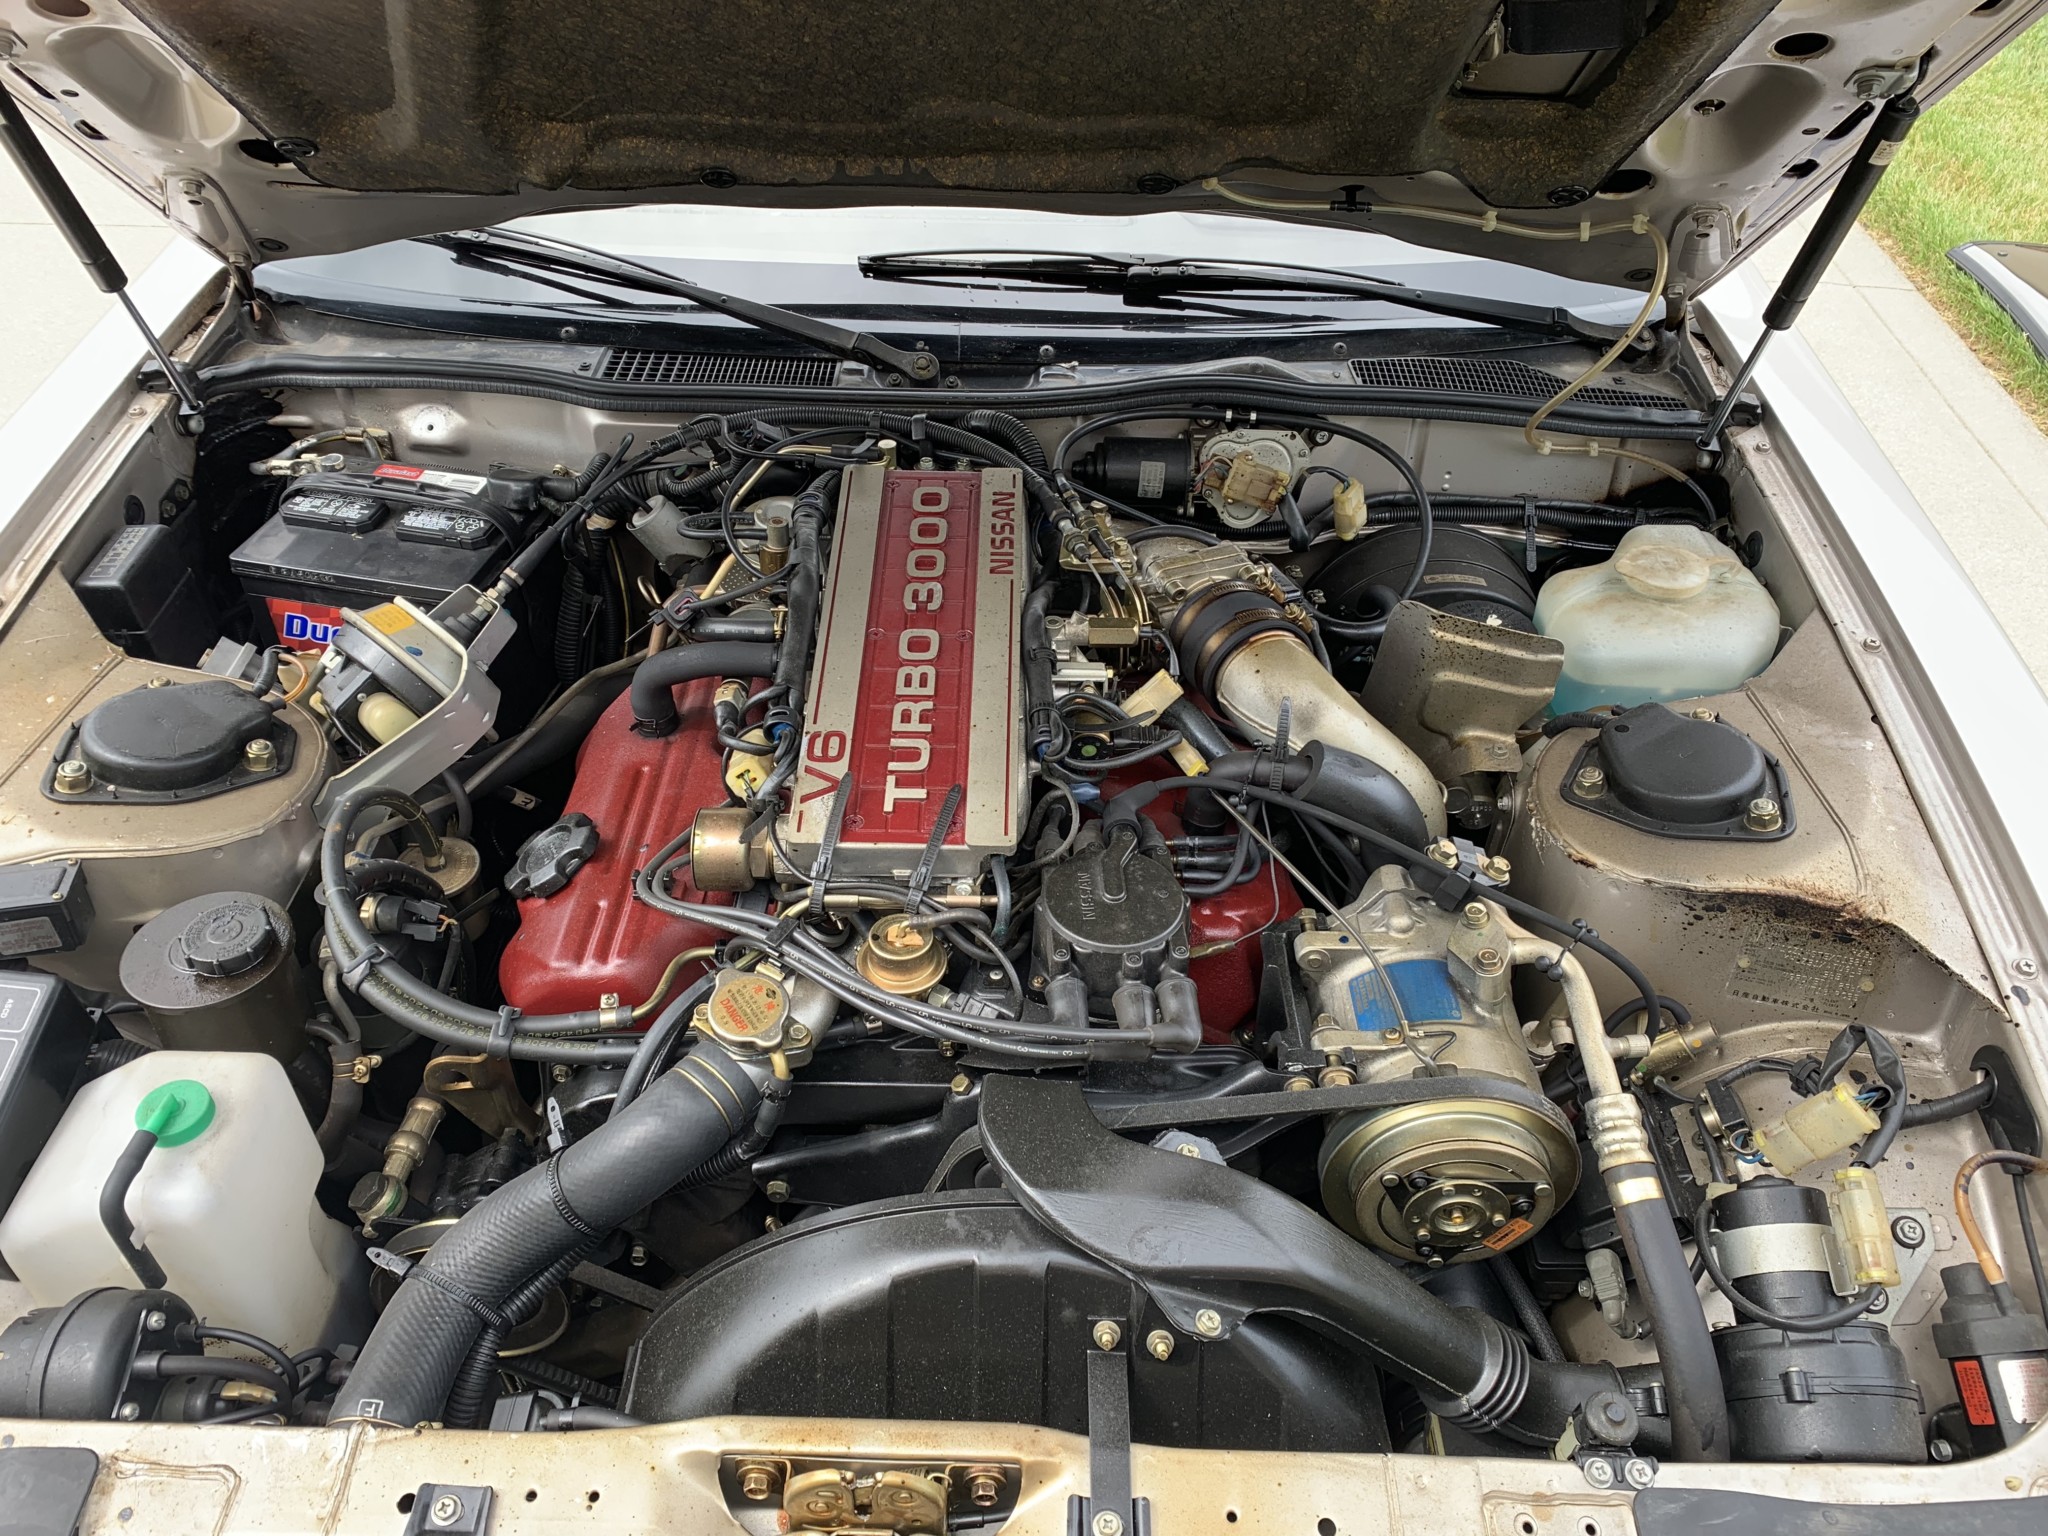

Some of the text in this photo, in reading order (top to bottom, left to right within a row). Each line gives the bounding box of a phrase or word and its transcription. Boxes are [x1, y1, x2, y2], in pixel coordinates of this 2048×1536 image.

[989, 491, 1016, 576] NISSAN
[883, 486, 950, 814] TURBO 3000
[799, 730, 847, 803] V6
[1077, 872, 1096, 919] NISSAN
[1, 998, 15, 1019] ASCD
[720, 998, 749, 1031] DANGER
